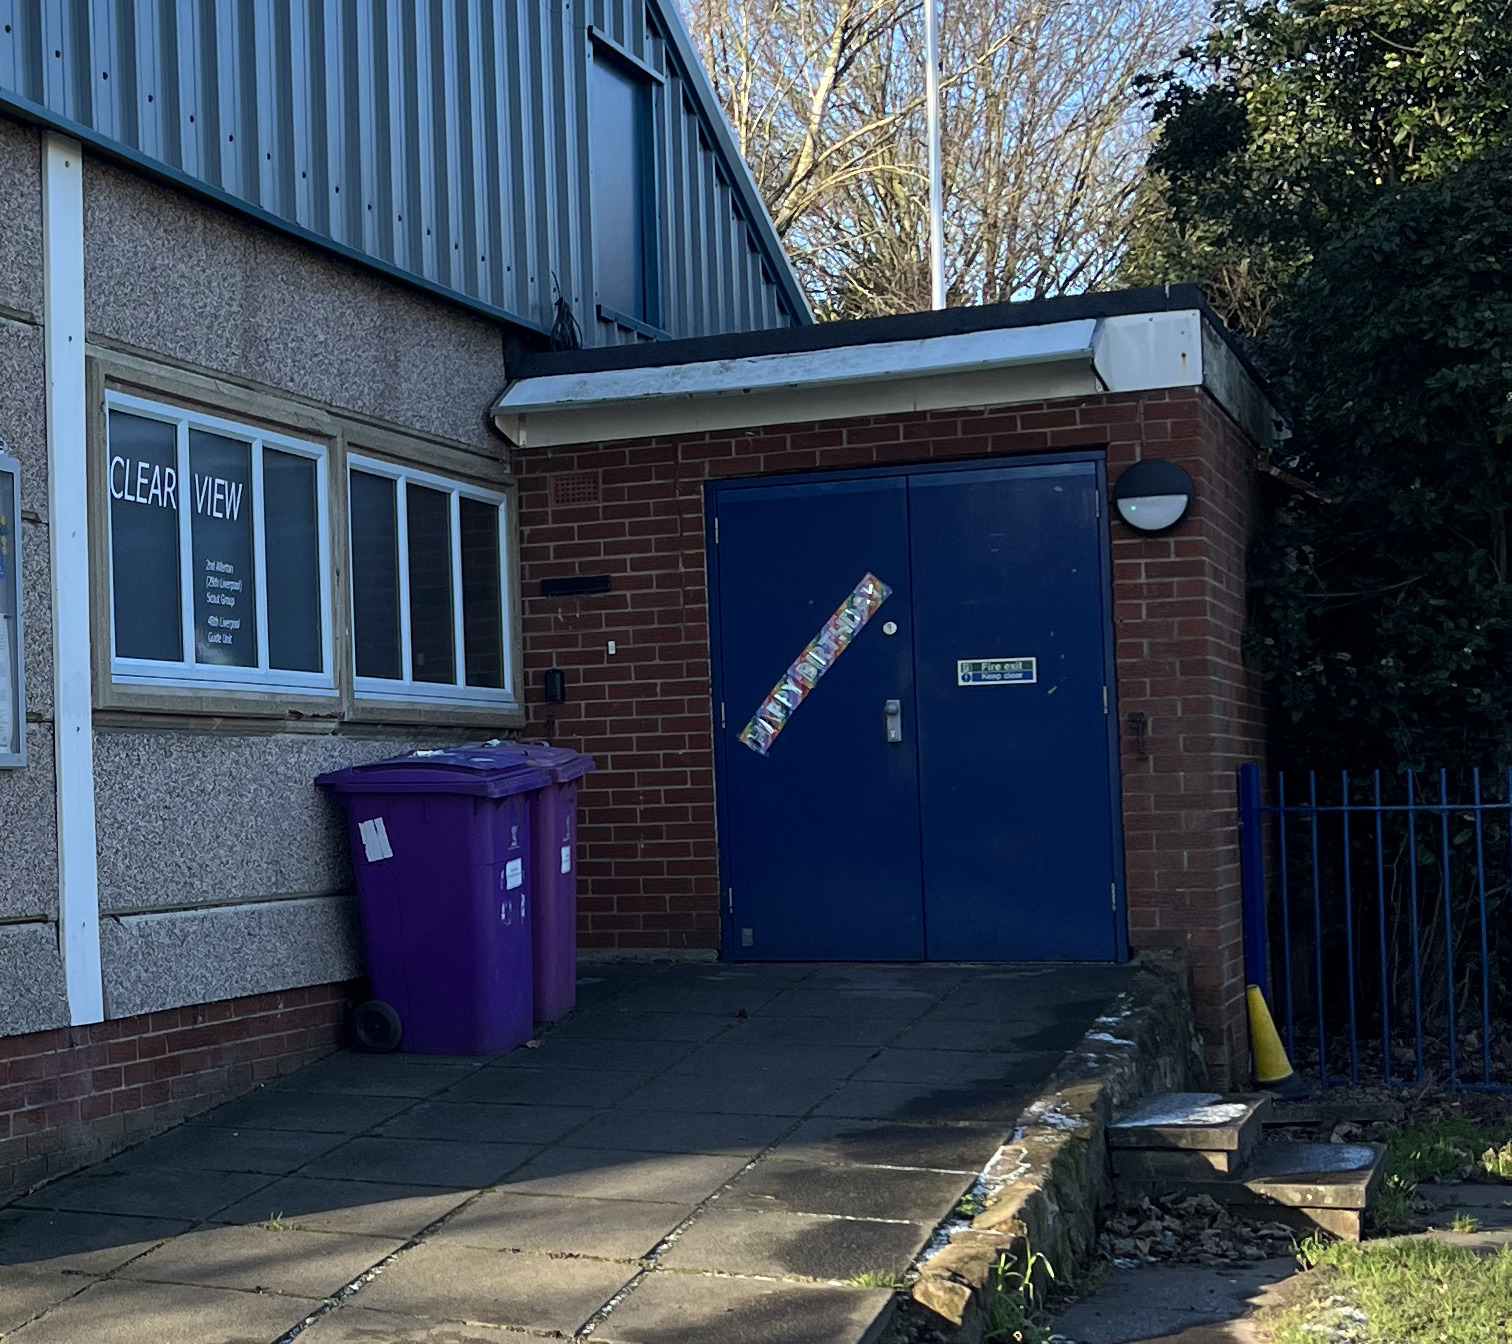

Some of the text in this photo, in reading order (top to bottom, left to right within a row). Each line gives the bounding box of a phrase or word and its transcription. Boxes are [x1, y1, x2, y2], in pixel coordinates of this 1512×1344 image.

[110, 455, 243, 521] CLEAR VIEW
[206, 591, 236, 607] Scout Group
[746, 583, 882, 748] HAPPY BIRTHDAY
[981, 661, 1023, 671] Fire exit
[981, 672, 1024, 680] Keep clear
